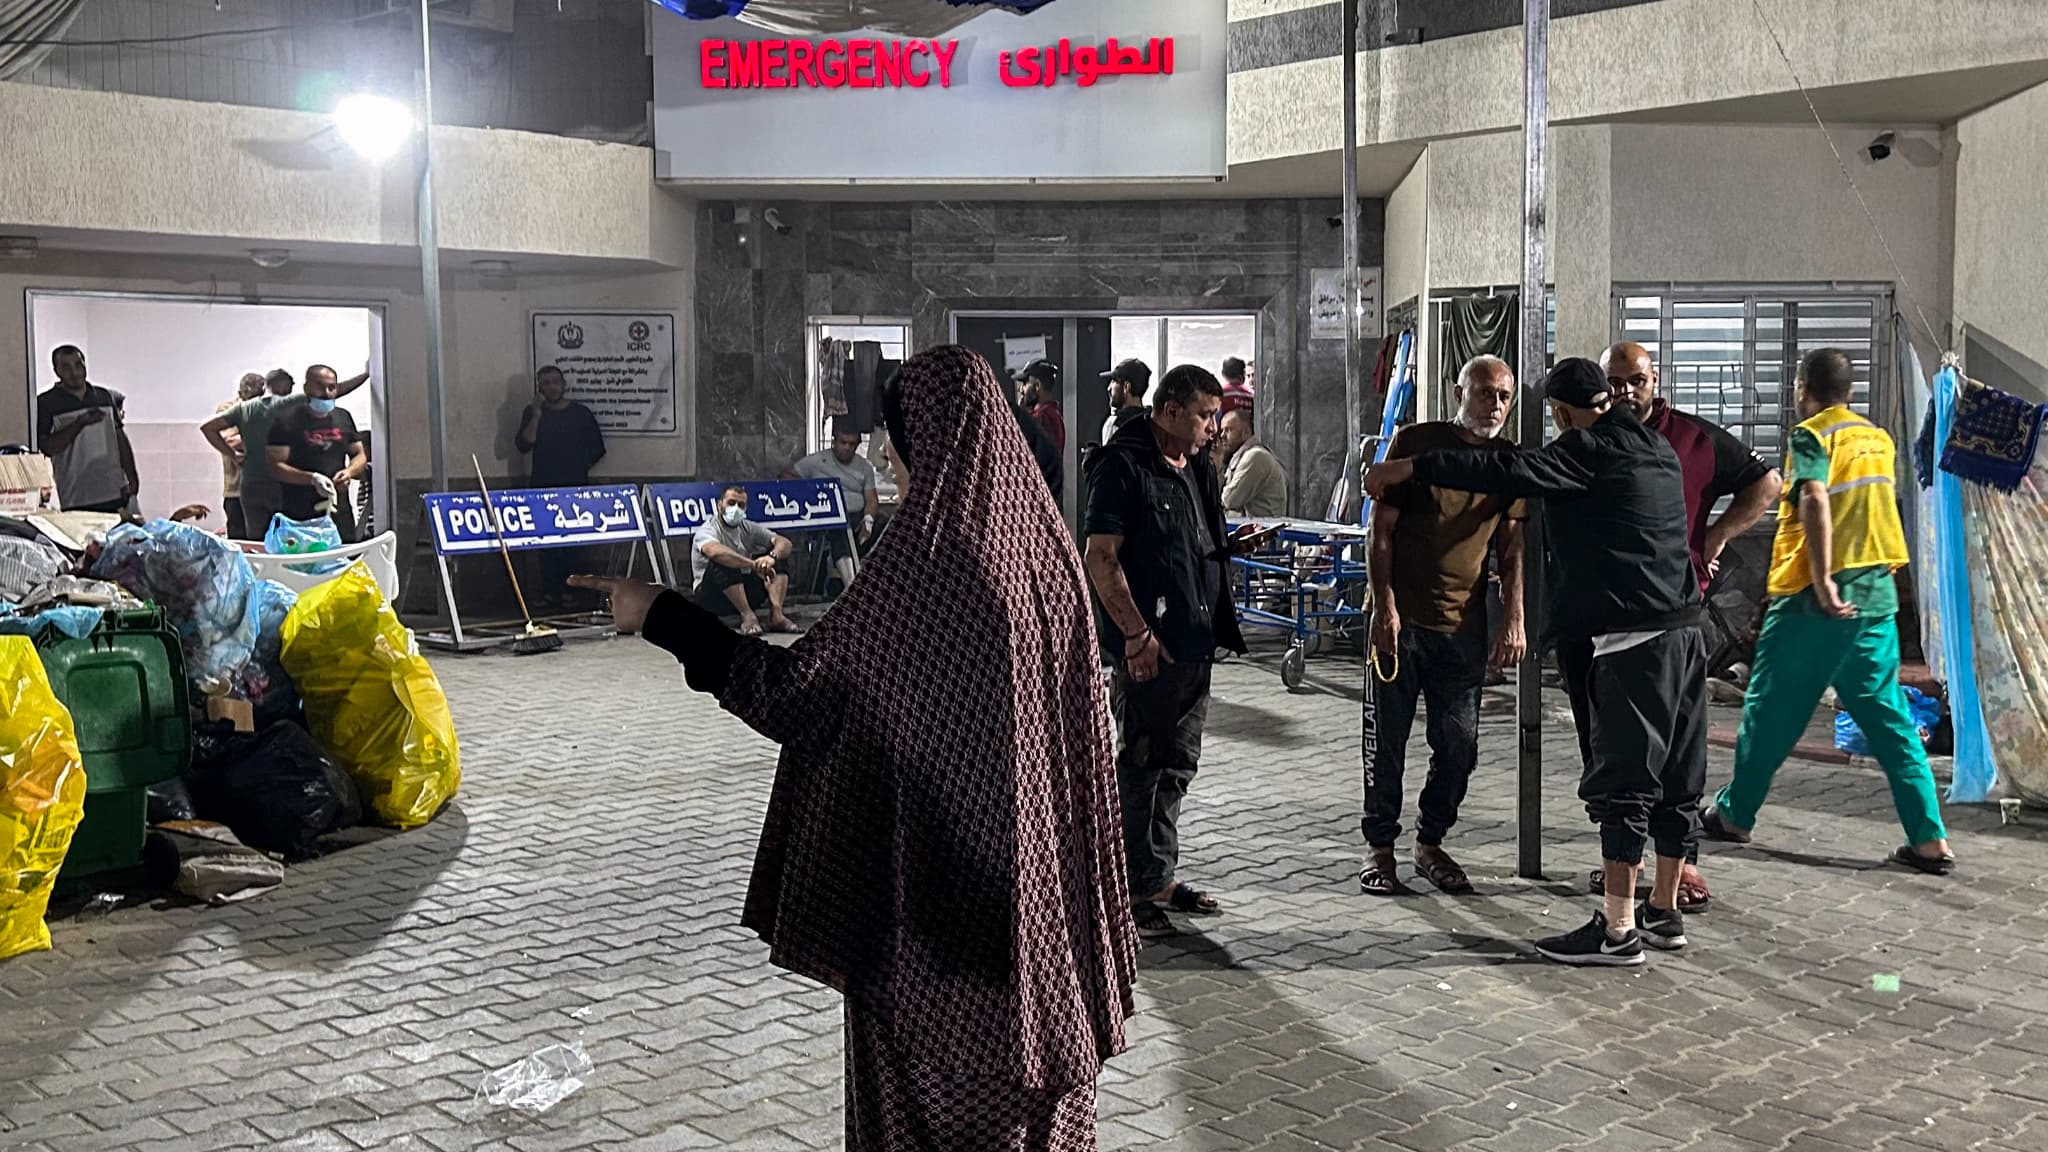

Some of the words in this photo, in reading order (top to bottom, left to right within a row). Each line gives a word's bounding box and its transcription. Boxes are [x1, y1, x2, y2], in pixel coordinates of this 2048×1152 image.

[700, 38, 959, 89] EMERGENCY
[998, 37, 1174, 89] الطوارئ
[627, 342, 651, 352] ICRC
[448, 505, 535, 536] POLICE
[546, 498, 630, 533] شرطة
[670, 497, 718, 523] POLI
[757, 491, 831, 520] شرطة
